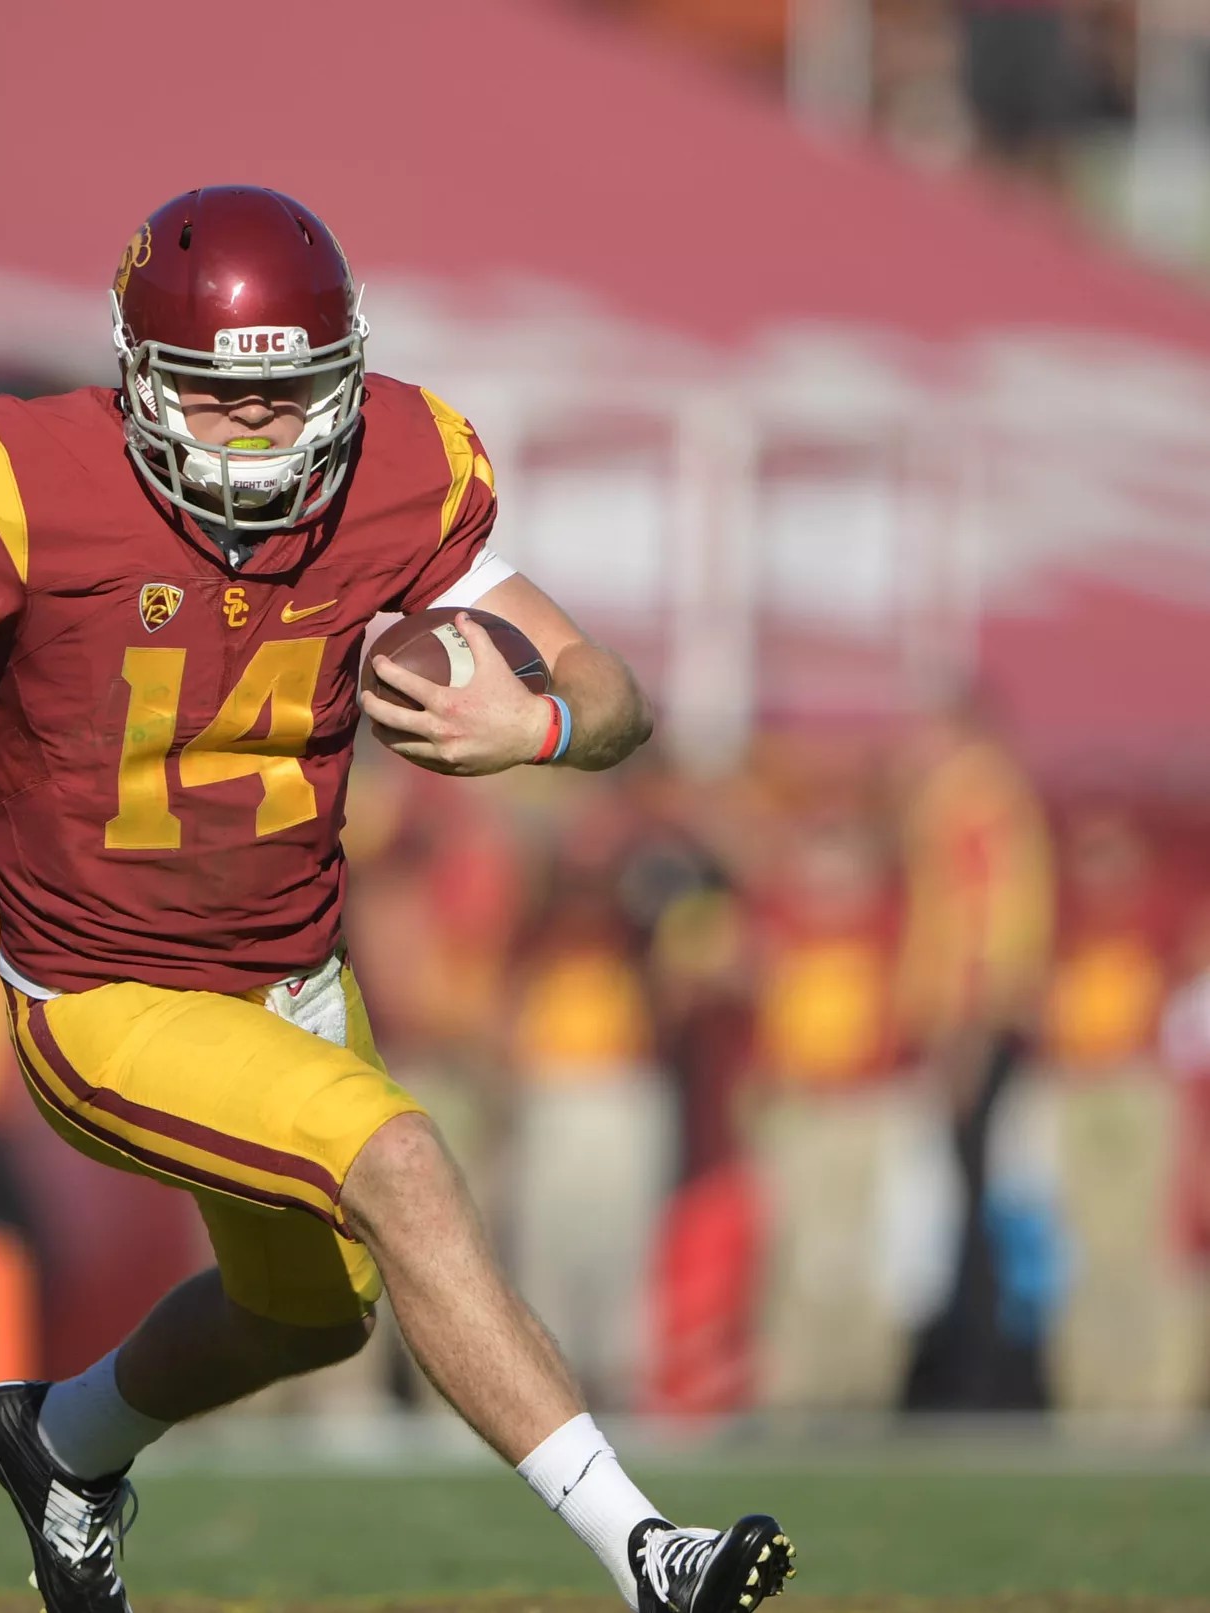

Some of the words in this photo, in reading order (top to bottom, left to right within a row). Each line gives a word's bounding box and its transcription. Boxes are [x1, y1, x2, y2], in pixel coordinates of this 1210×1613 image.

[237, 332, 286, 353] USC
[233, 480, 261, 489] FIGHT
[142, 585, 181, 616] PAC
[145, 604, 167, 624] 12
[104, 636, 327, 849] 14
